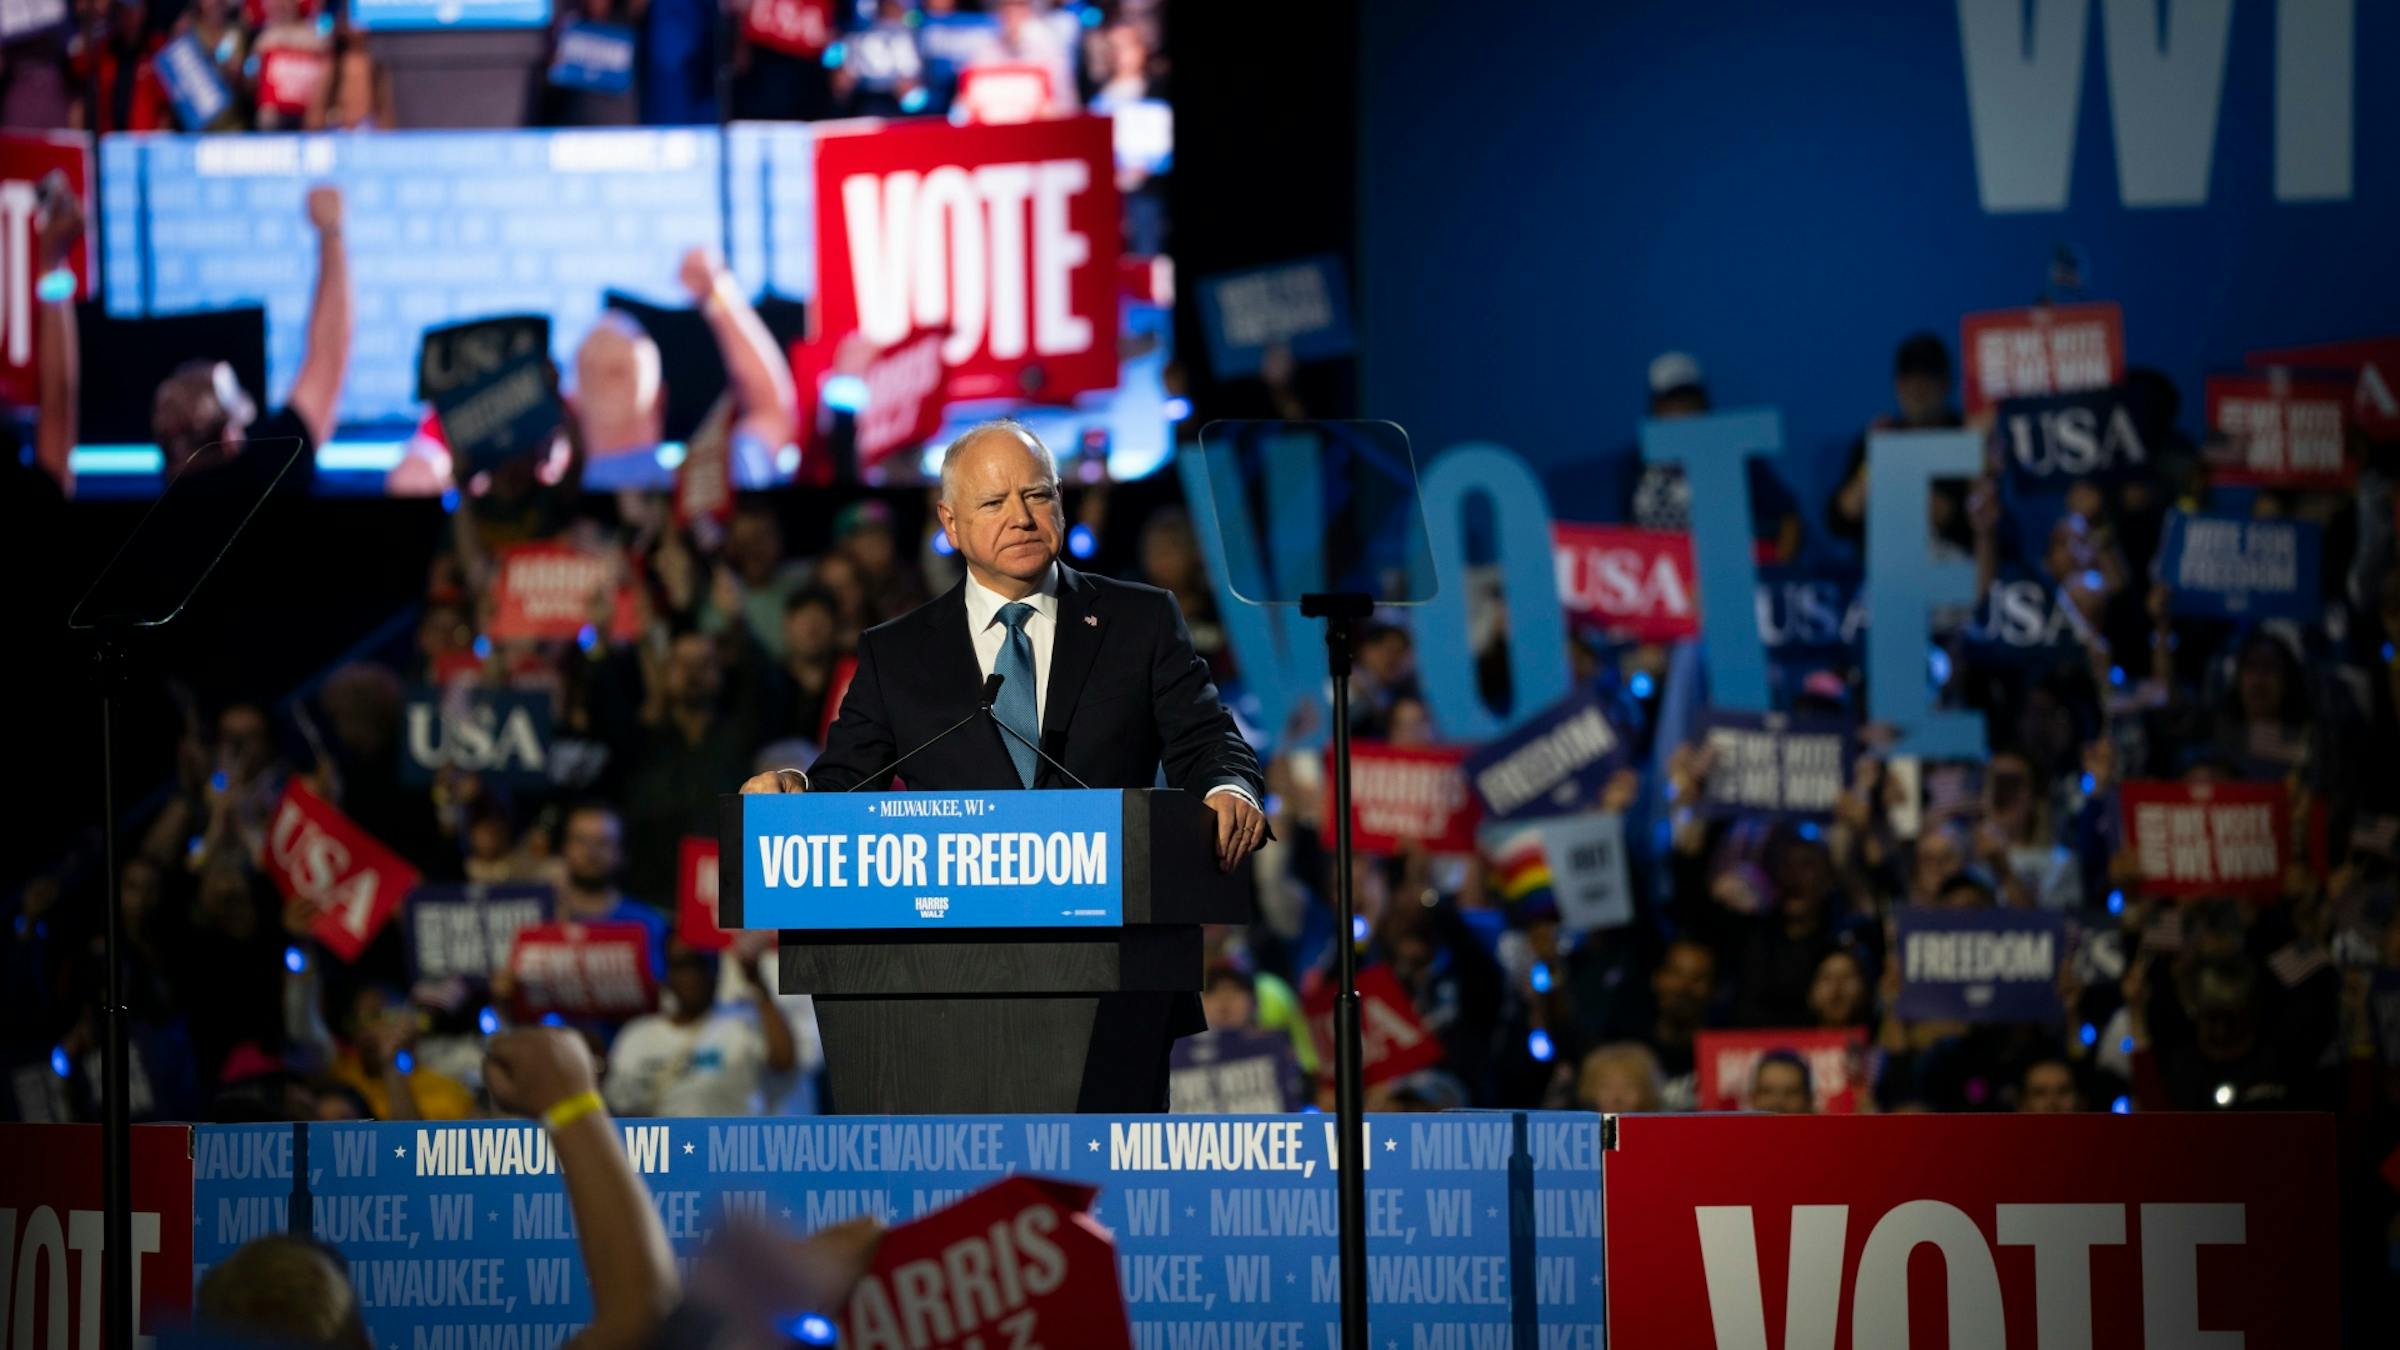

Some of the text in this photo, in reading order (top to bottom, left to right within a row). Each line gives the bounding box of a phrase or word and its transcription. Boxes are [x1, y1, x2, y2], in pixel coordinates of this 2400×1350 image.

[1957, 0, 2357, 214] WI
[842, 160, 1092, 366] VOTE
[2008, 403, 2149, 478] USA
[1178, 408, 1990, 757] VOTE
[1557, 545, 1690, 617] USA
[406, 702, 546, 772] USA
[1477, 704, 1619, 816] FREEDOM
[880, 799, 984, 818] MILWAUKEE, WI
[272, 797, 381, 940] USA
[759, 834, 848, 888] VOTE
[857, 833, 928, 887] FOR
[937, 831, 1107, 886] FREEDOM
[915, 897, 949, 910] HARRIS
[920, 910, 945, 919] WALZ
[1904, 929, 2055, 983] FREEDOM
[195, 1129, 376, 1186] AUKE, WI
[625, 1126, 670, 1174] WI
[1025, 1123, 1070, 1171] WI
[1110, 1122, 1318, 1179] MILWAUKEE,
[429, 1193, 474, 1241] WI
[1124, 1188, 1170, 1237] WI
[1210, 1188, 1472, 1246] MILWAUEE, WI
[0, 1204, 161, 1350] OT
[348, 1257, 571, 1314] ILWAUKEE, WI
[1224, 1255, 1271, 1304] WI
[1311, 1255, 1576, 1314] MWAUKEE, WI
[1694, 1200, 2247, 1350] VOTE
